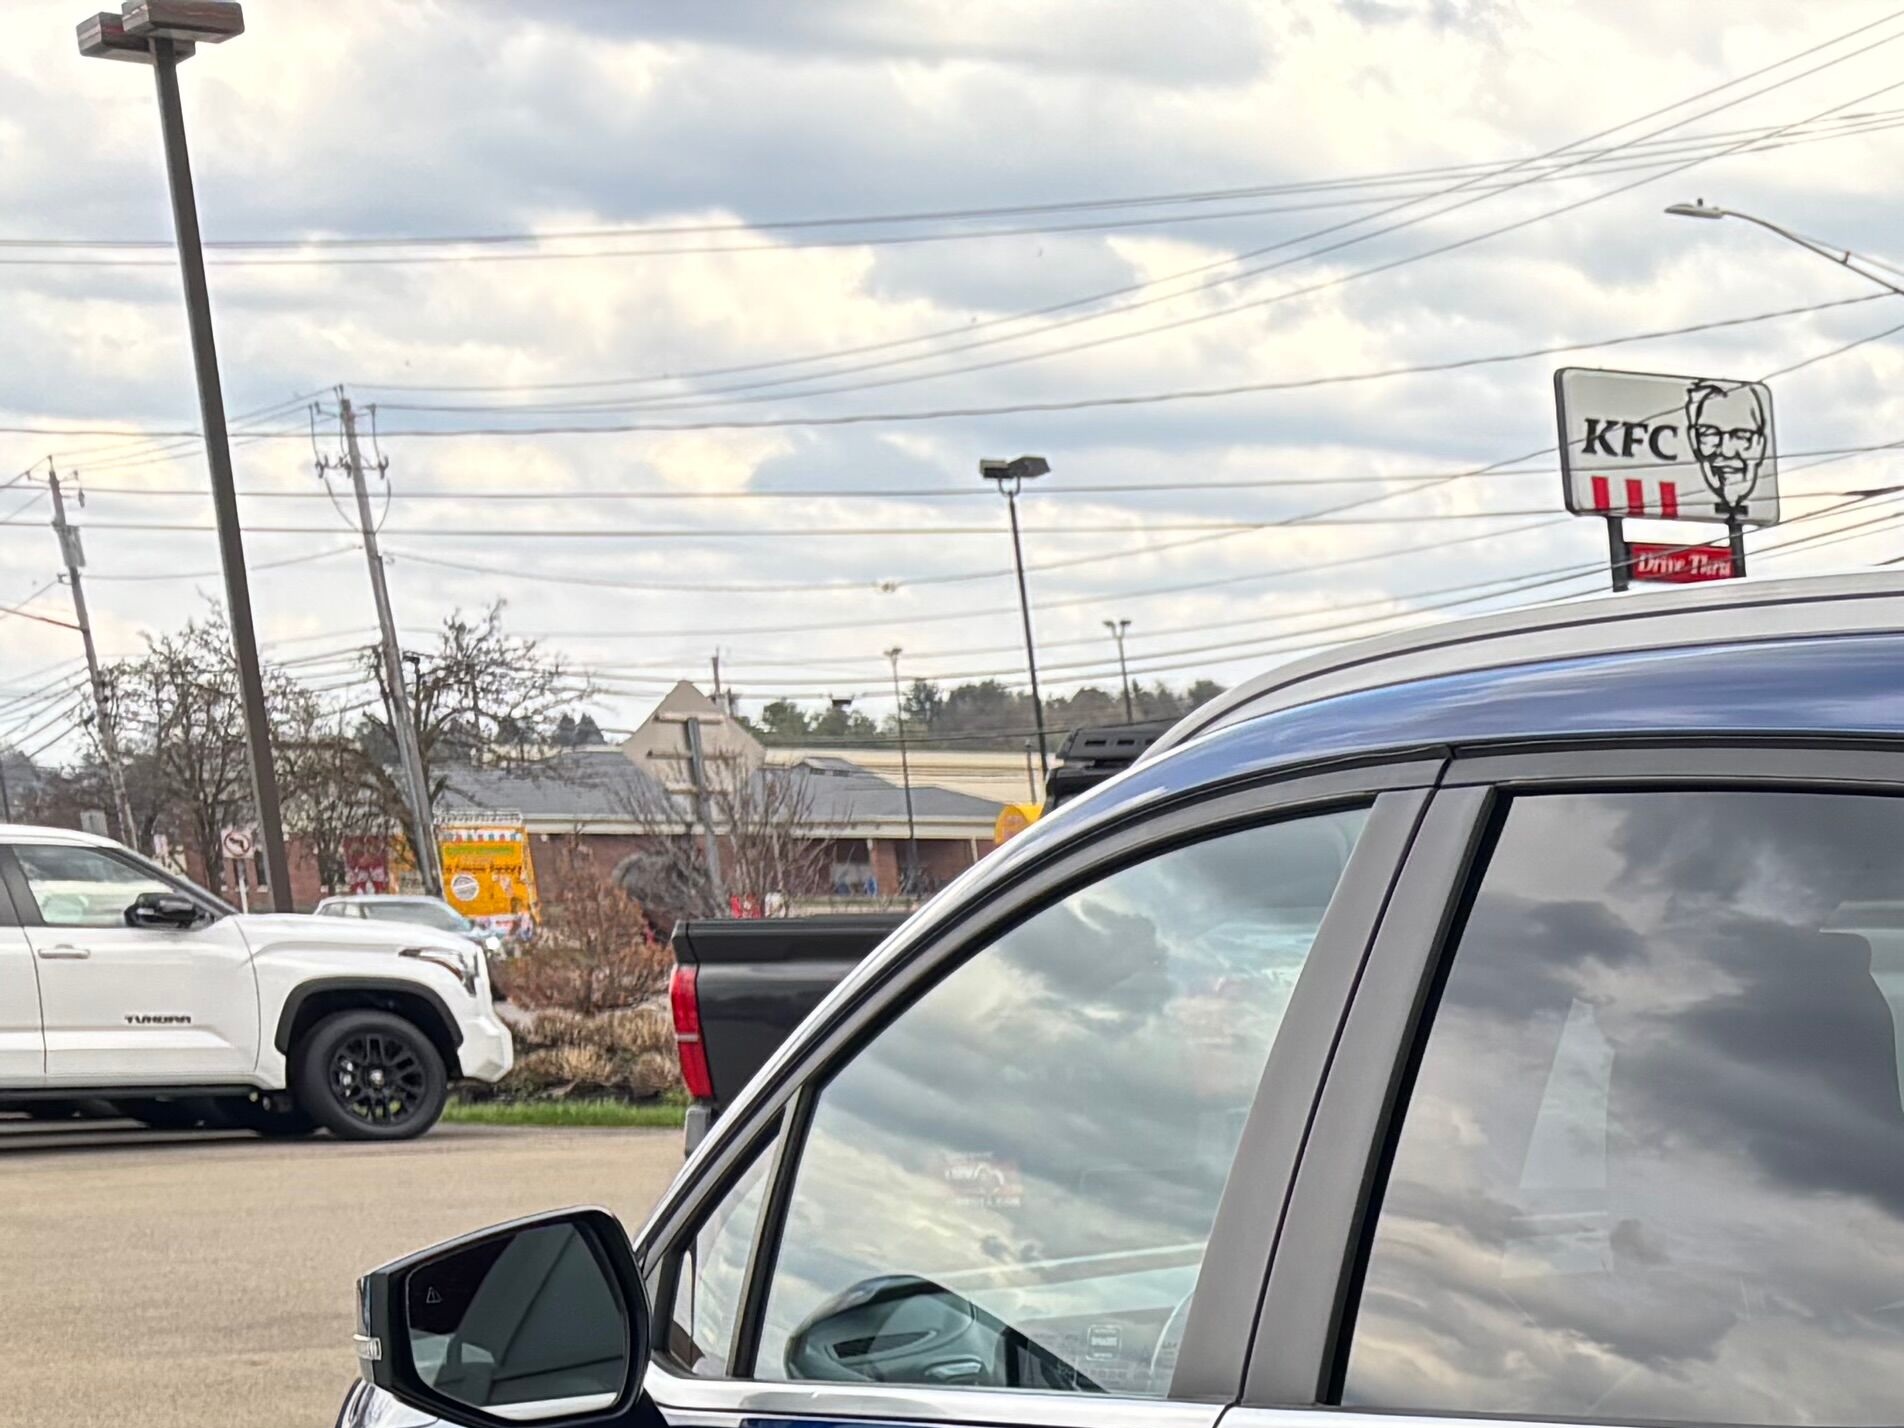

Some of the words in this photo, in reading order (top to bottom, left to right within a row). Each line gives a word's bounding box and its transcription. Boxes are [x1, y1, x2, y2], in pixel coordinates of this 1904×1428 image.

[1581, 417, 1679, 461] KFC
[1637, 552, 1685, 573] Drive
[1688, 554, 1731, 577] Thru
